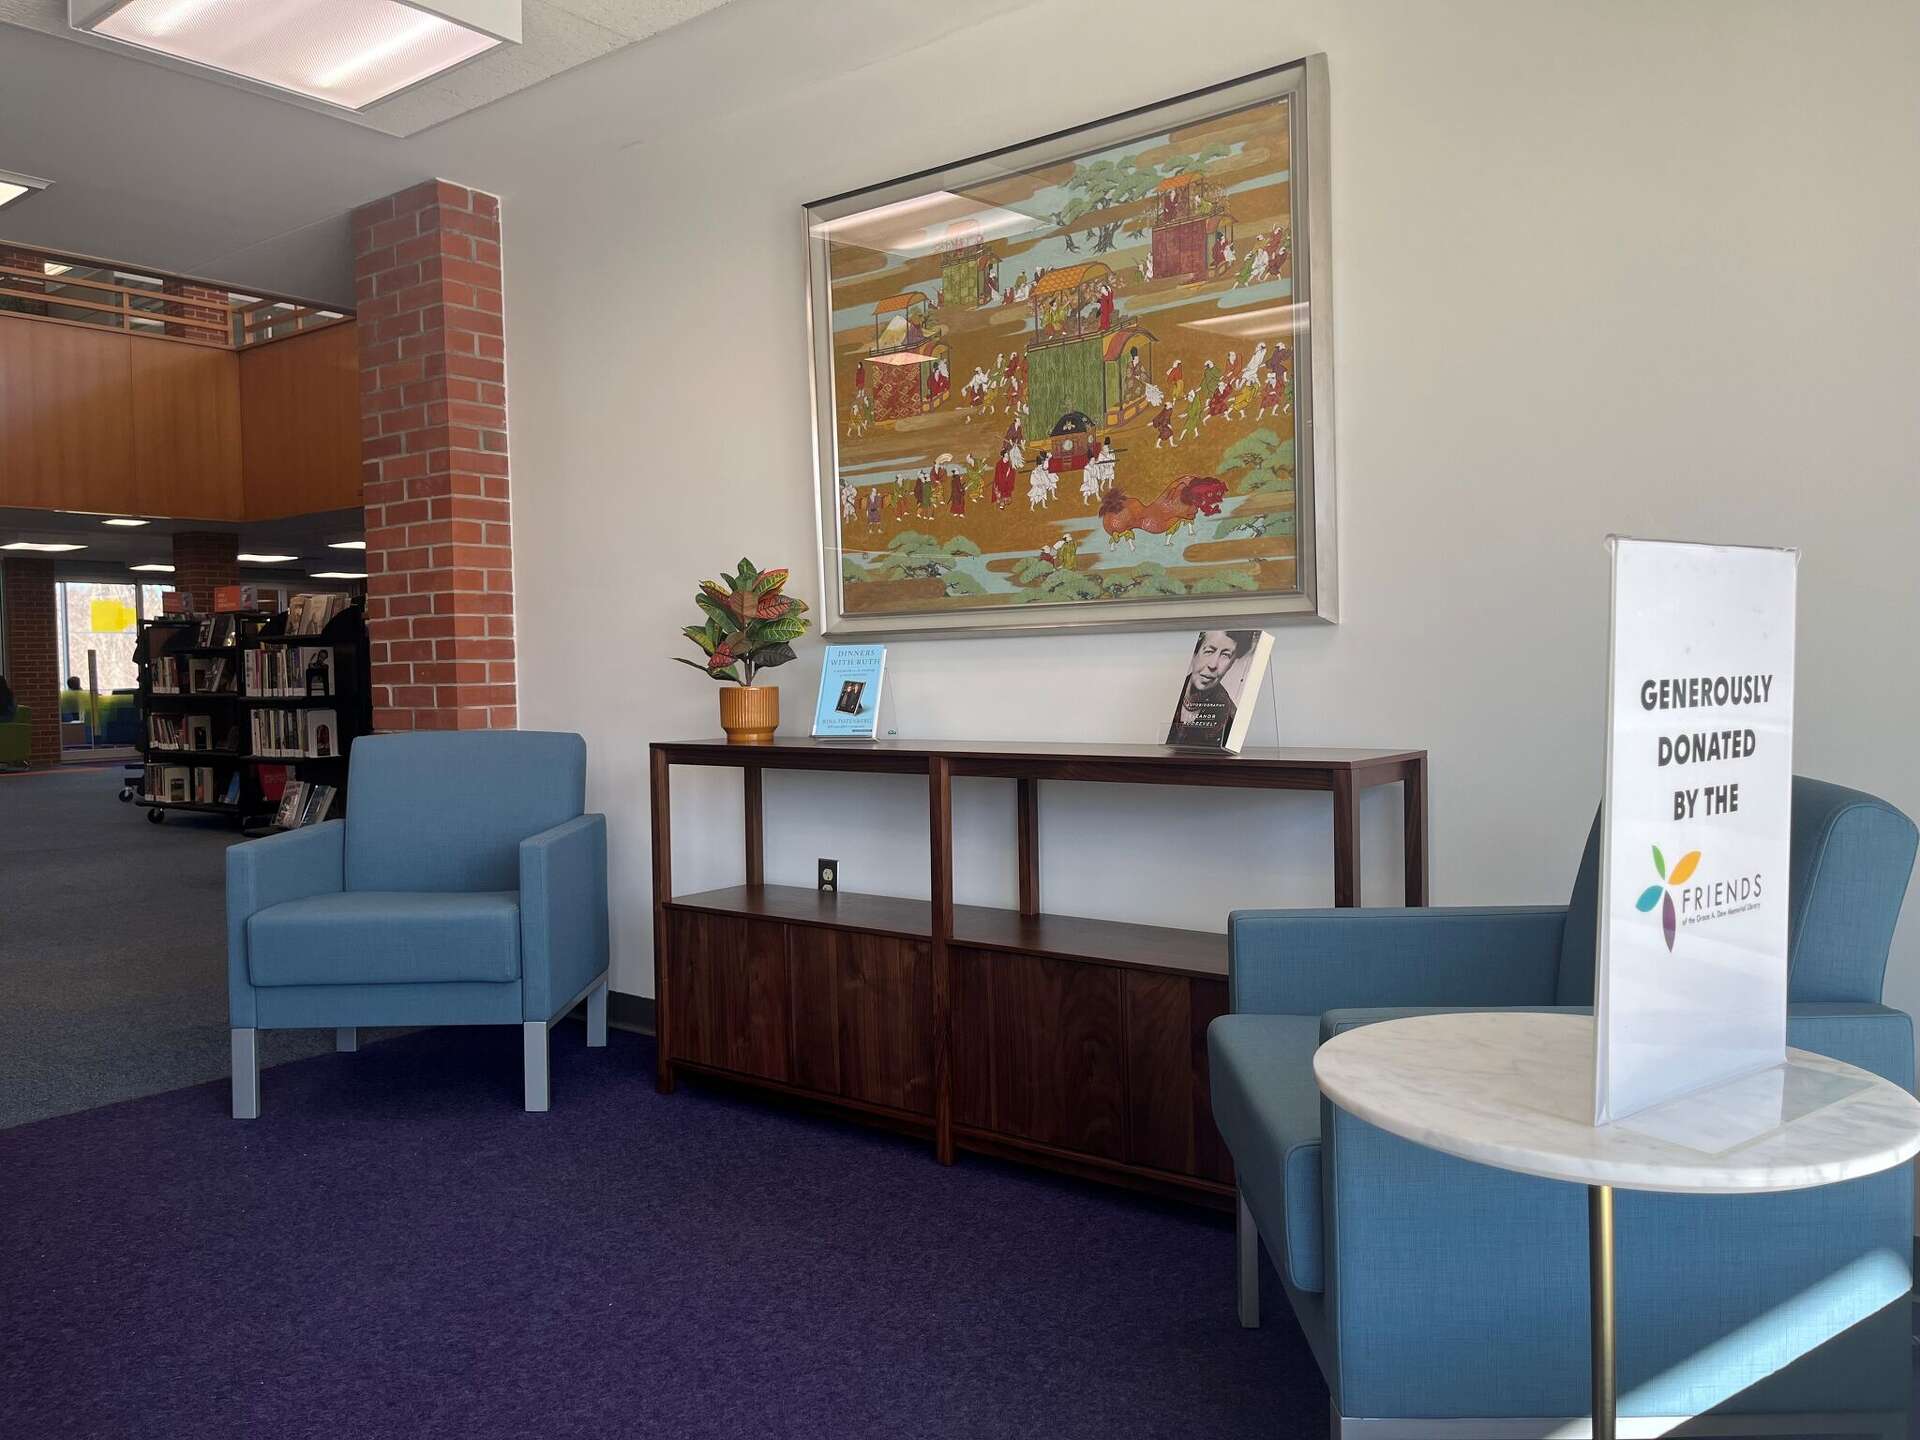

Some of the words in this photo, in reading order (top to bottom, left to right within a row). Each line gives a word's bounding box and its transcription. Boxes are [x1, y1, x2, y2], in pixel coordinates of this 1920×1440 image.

[1640, 674, 1773, 711] GENEROUSLY
[1658, 728, 1757, 767] DONATED
[1673, 788, 1699, 821] BY
[1704, 783, 1739, 816] THE
[1682, 873, 1762, 914] FRIENDS
